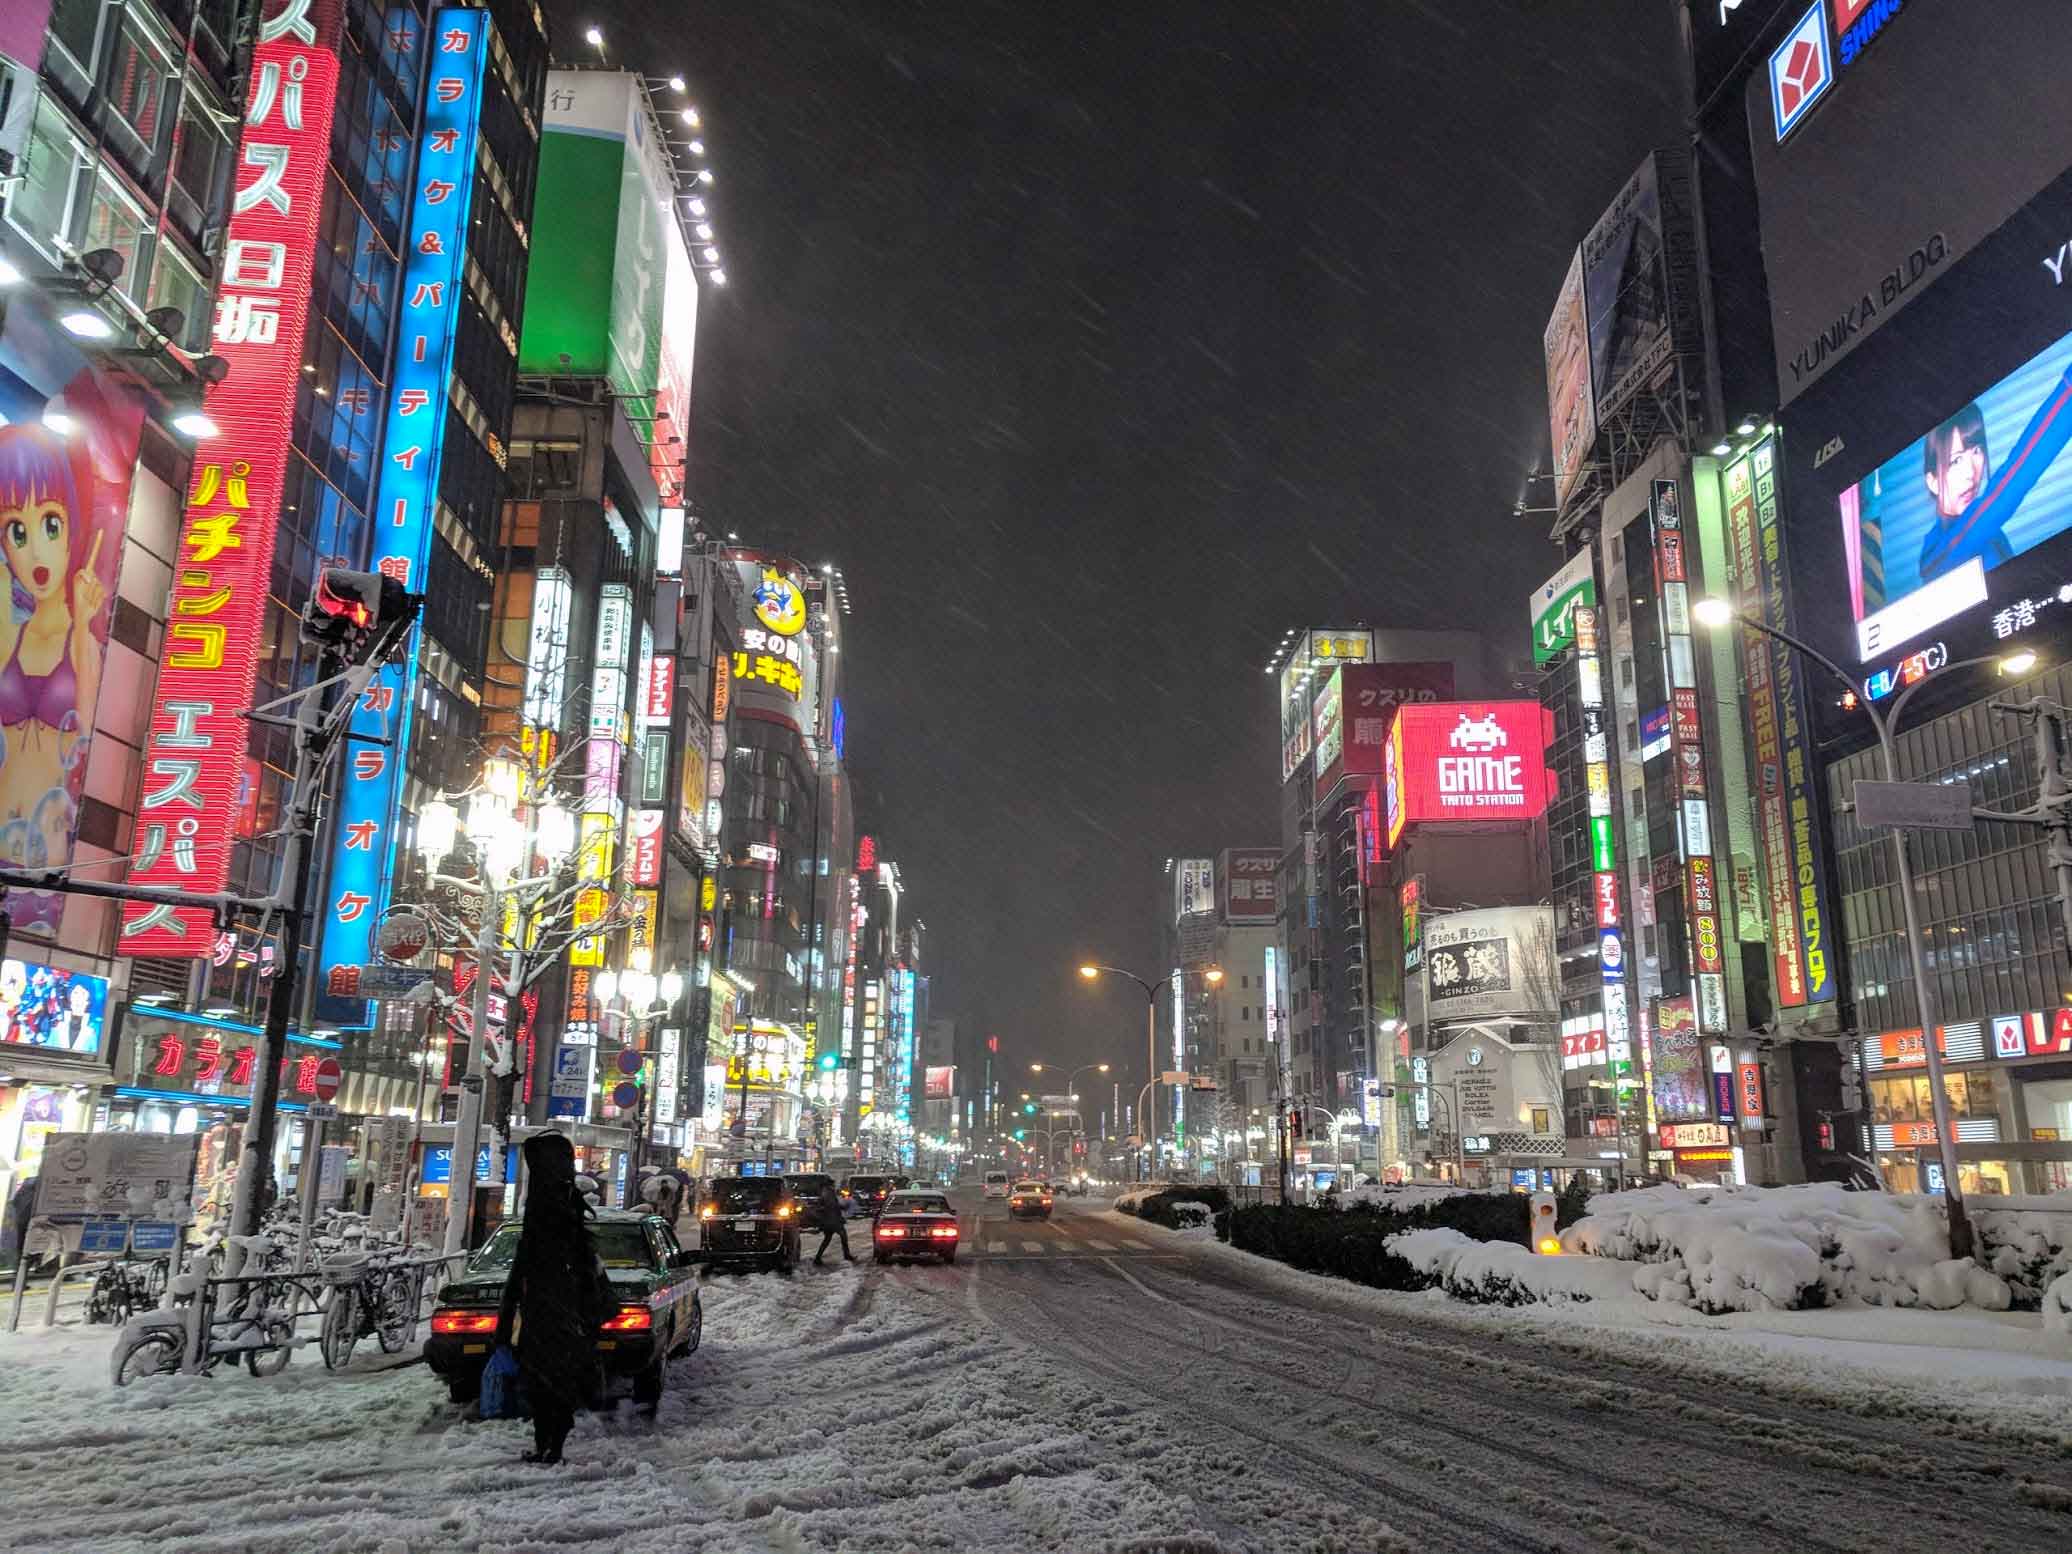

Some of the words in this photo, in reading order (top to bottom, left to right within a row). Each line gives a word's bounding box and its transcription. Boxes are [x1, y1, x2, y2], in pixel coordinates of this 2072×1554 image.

[2043, 240, 2072, 285] Y
[1789, 295, 1878, 382] YUNIKA
[169, 461, 250, 669] パチンコ
[652, 671, 669, 715] アイフル
[1753, 690, 1777, 762] FREE
[1438, 756, 1524, 792] GAME
[125, 700, 214, 937] エスパス
[1440, 794, 1473, 805] TAITO
[1474, 793, 1524, 805] STATION
[328, 682, 394, 998] カラオケ館
[638, 838, 655, 872] アコム
[1600, 875, 1617, 923] アイフル
[1446, 987, 1479, 997] GINZO
[156, 1034, 321, 1095] カラオ館
[1565, 1035, 1601, 1054] アイフ
[1744, 1069, 1760, 1111] 吉野家
